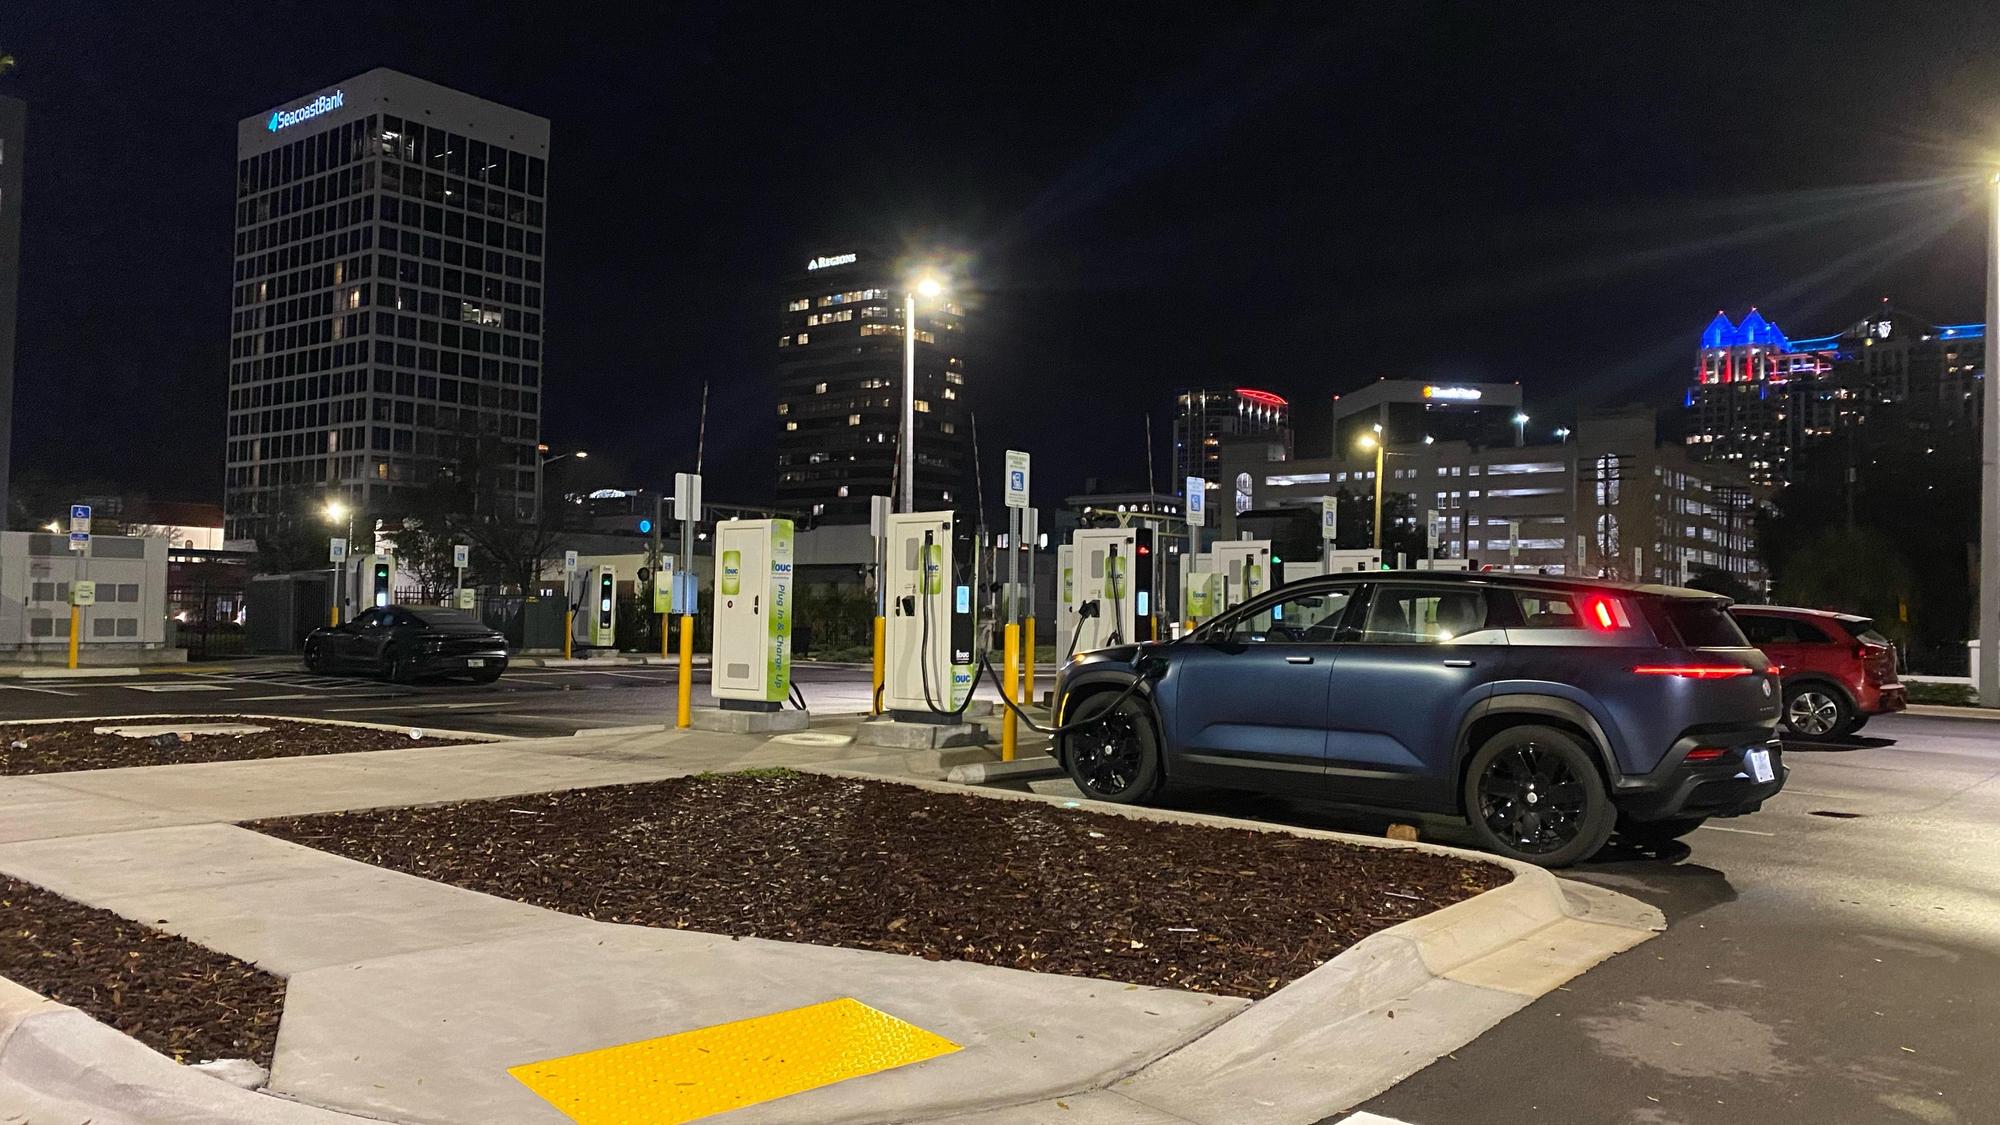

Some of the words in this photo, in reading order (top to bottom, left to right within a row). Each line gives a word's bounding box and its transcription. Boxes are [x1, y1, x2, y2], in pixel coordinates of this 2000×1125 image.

[278, 90, 343, 128] SeacoastBank
[776, 584, 785, 606] Plug
[778, 609, 784, 620] In
[777, 622, 784, 631] &
[775, 634, 783, 671] Charge
[774, 674, 783, 688] Up
